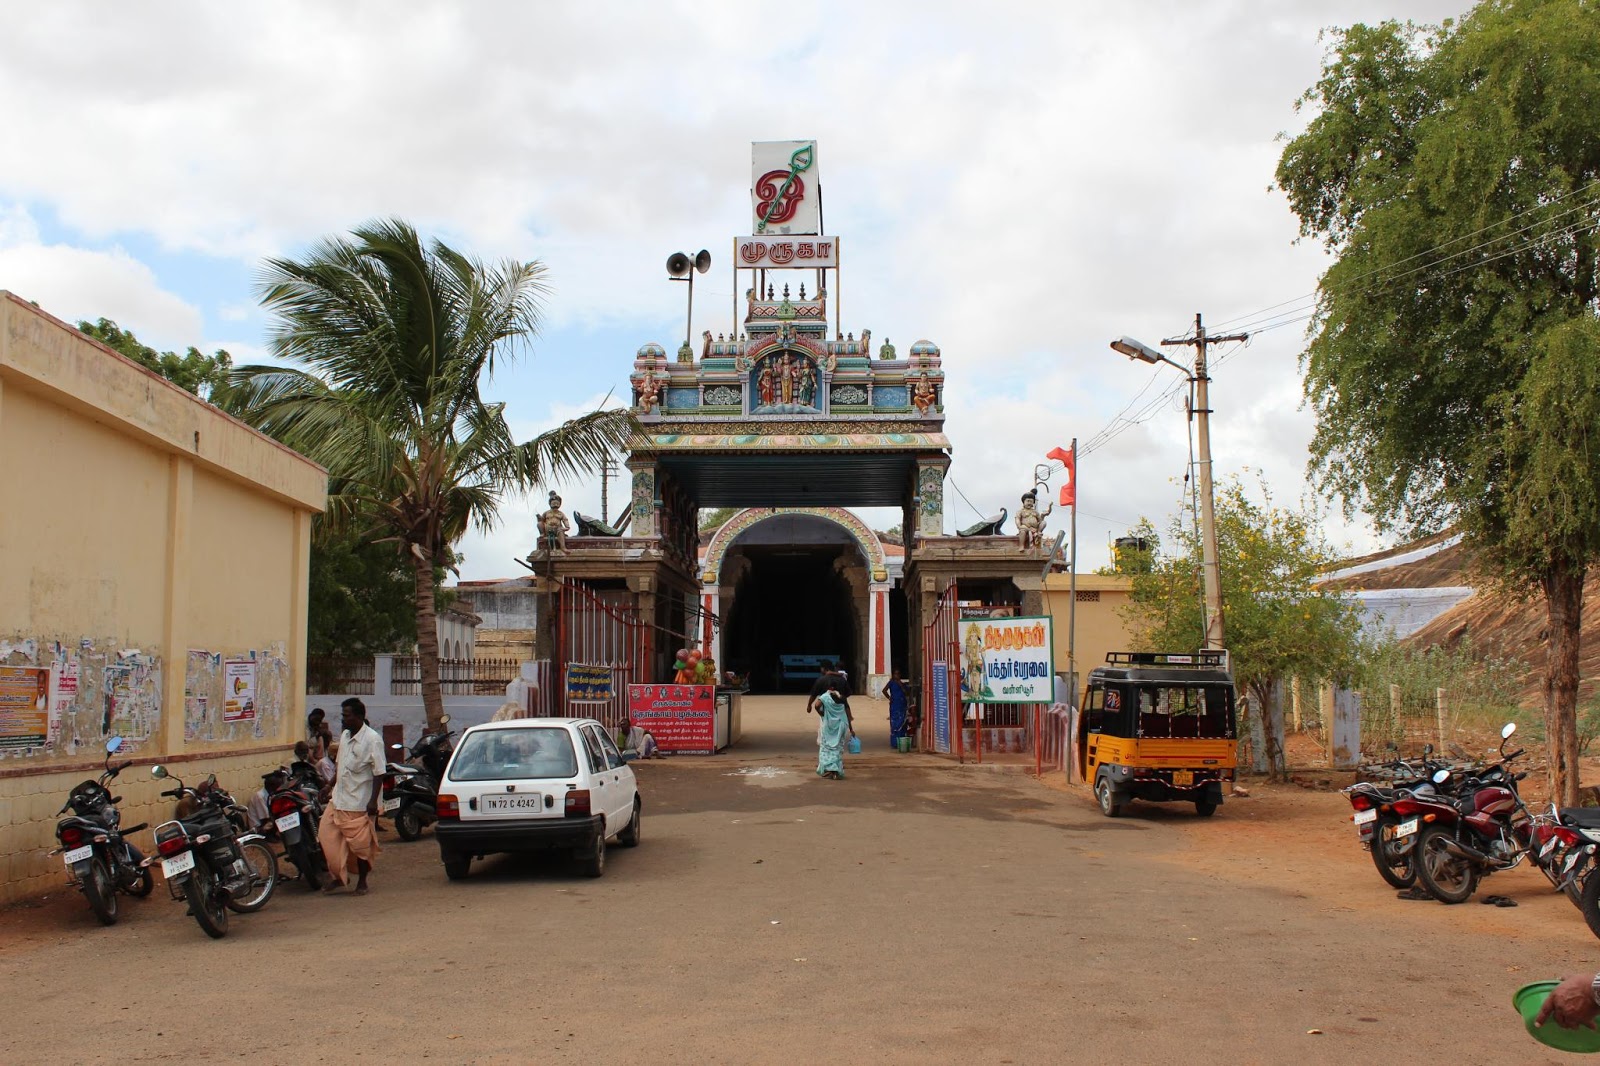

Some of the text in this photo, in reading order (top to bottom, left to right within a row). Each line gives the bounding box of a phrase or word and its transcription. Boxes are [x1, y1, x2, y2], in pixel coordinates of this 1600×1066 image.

[740, 241, 832, 265] முருகா
[984, 621, 1046, 651] திருமுருகன்
[988, 658, 1048, 680] பக்தர் பேரவை
[1002, 684, 1034, 697] வள்ளியூர்
[632, 709, 712, 719] தேங்காய் பழக்கடை
[488, 799, 535, 808] TN 72 C 4242
